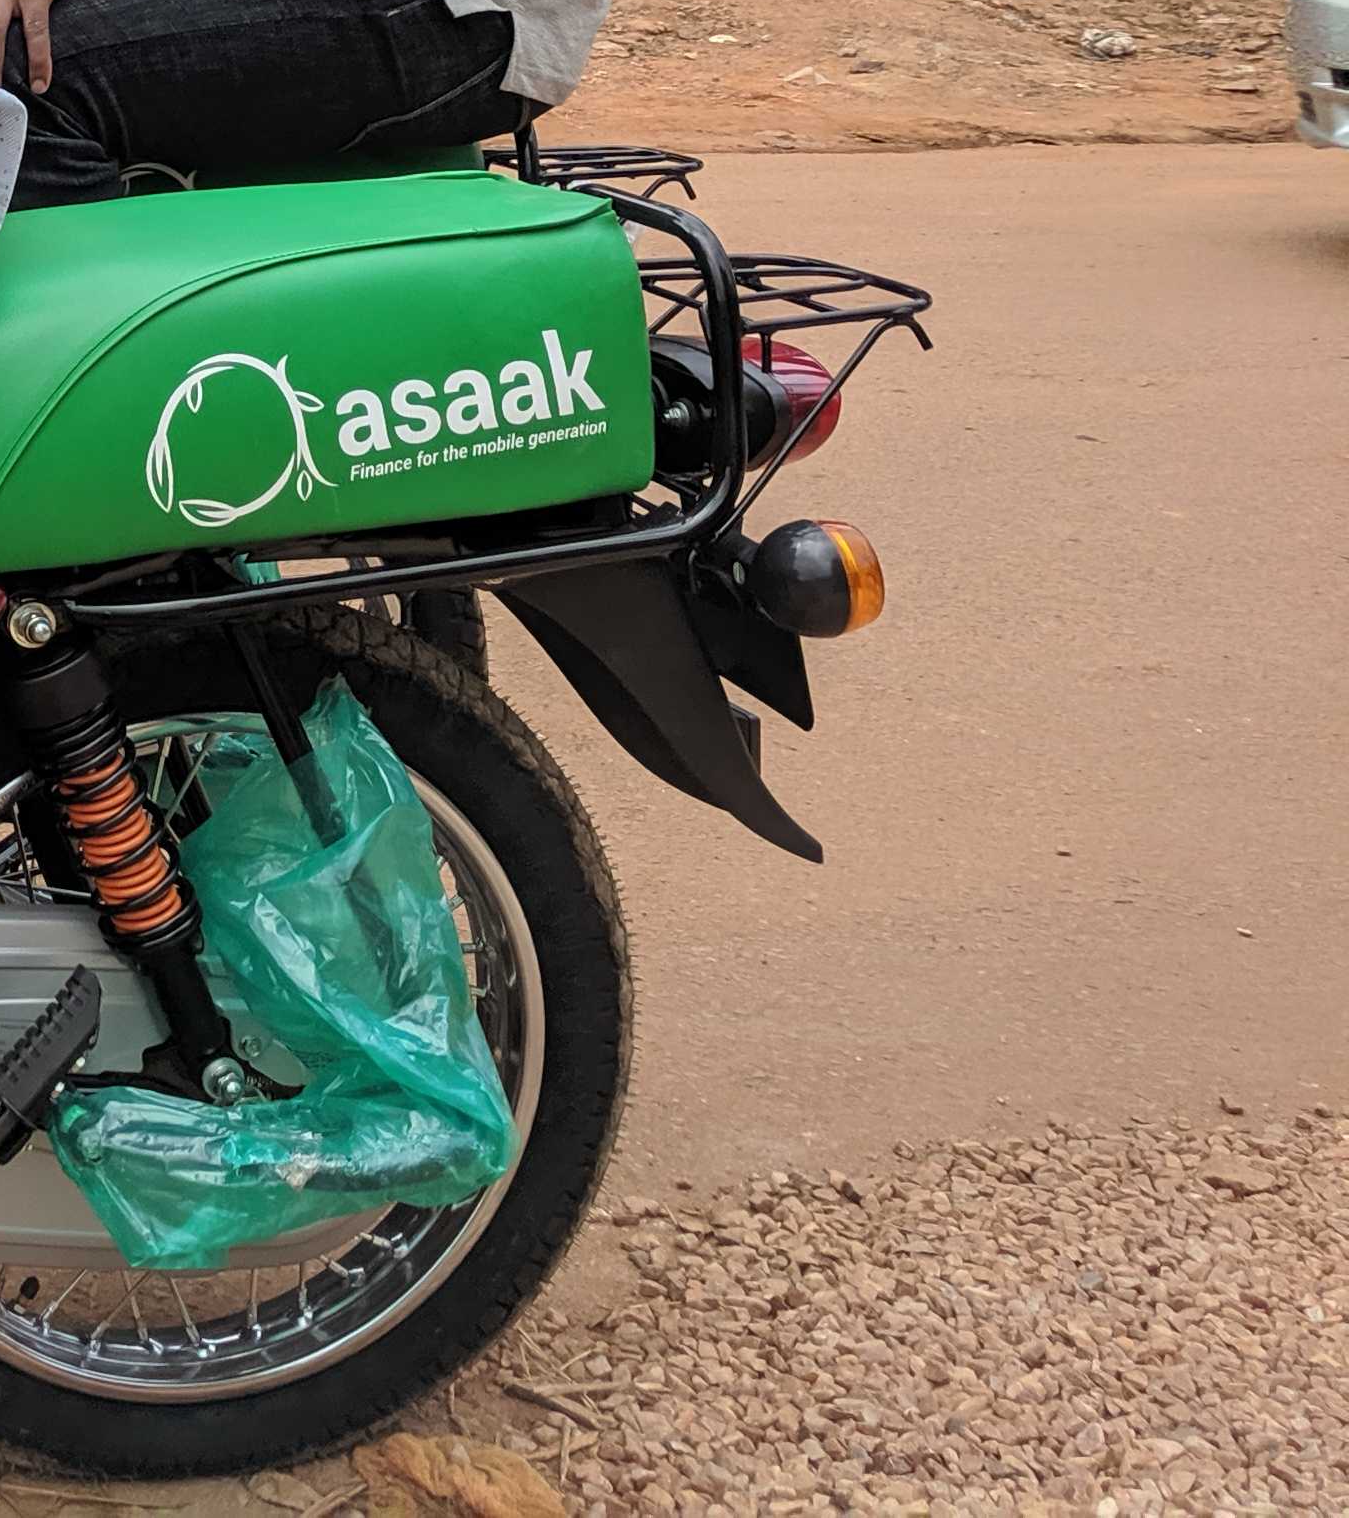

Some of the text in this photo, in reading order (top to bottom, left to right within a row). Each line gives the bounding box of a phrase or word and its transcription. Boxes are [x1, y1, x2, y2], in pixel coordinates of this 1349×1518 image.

[335, 329, 606, 457] asaak
[350, 420, 607, 481] Finance for the mobile generation
